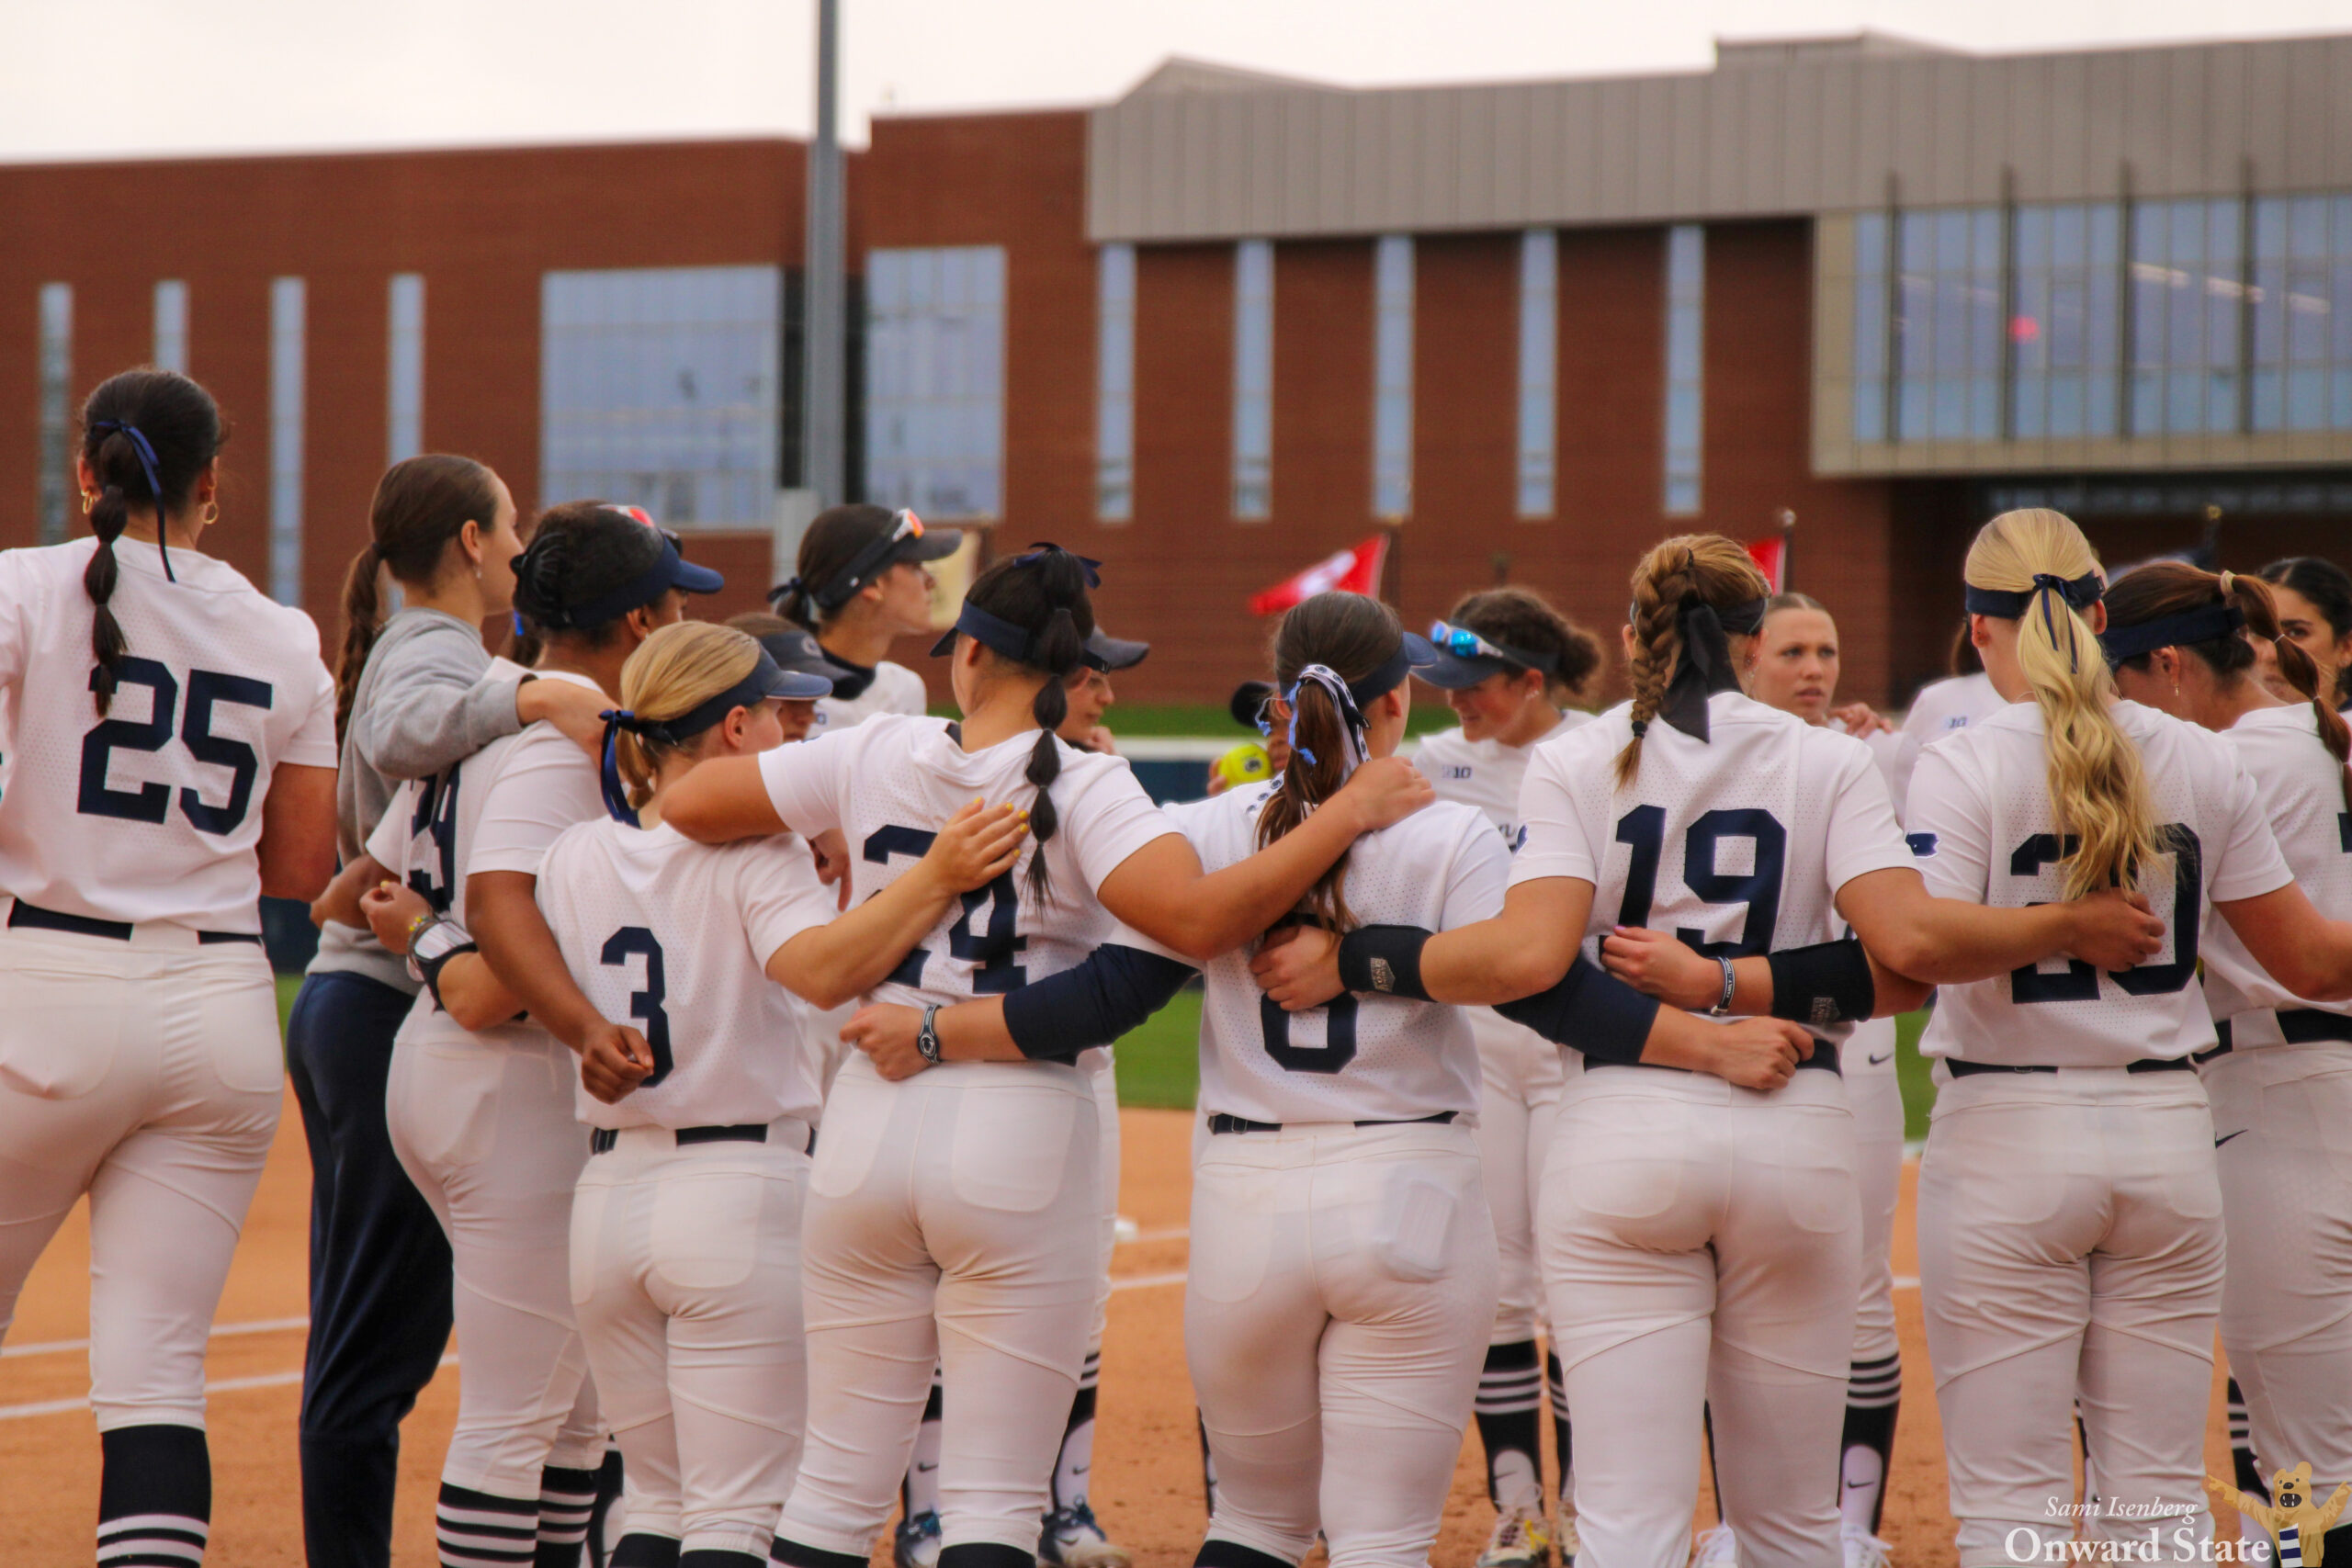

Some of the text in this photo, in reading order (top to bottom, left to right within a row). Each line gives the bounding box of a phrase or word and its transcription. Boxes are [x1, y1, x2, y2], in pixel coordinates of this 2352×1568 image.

[77, 654, 273, 836] 25
[1599, 805, 1787, 961] 19
[2010, 823, 2201, 1004] 20
[600, 927, 673, 1088] 3
